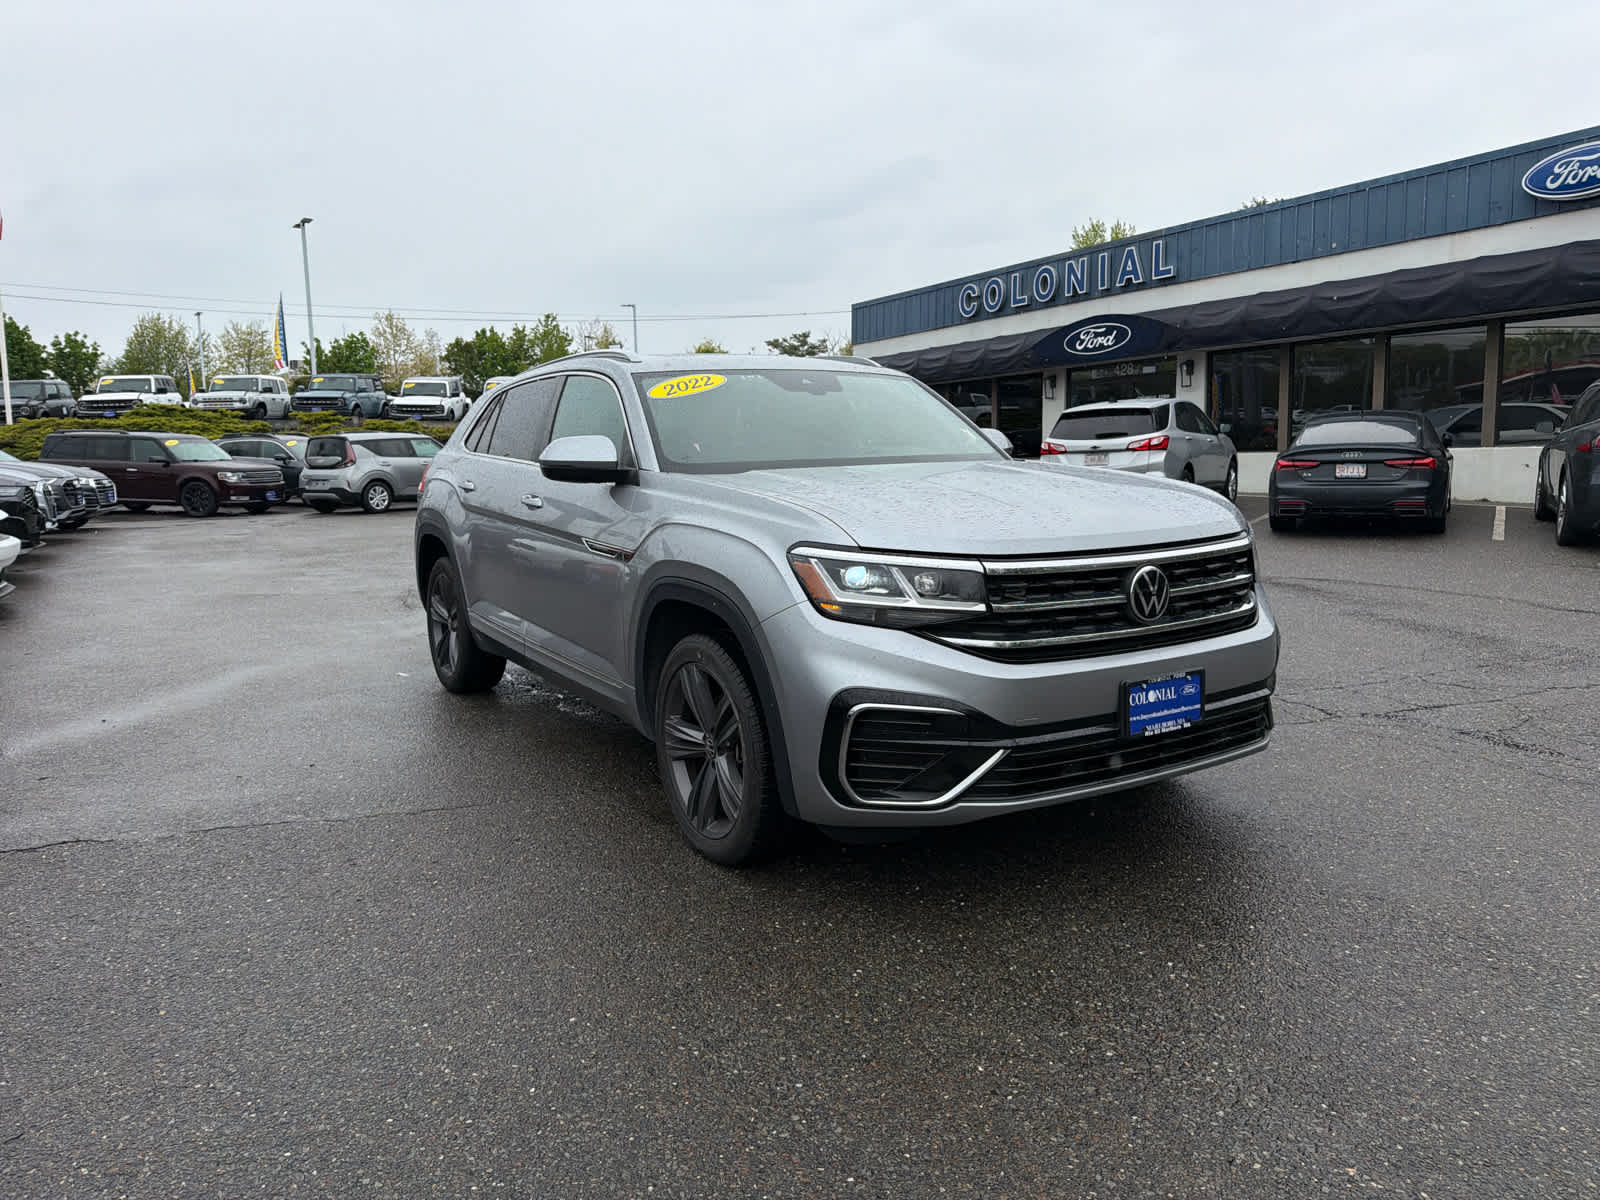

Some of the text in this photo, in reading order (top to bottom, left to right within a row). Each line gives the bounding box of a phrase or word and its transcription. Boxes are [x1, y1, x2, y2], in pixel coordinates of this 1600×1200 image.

[1546, 152, 1600, 190] For
[959, 240, 1174, 318] COLONIAL
[1076, 328, 1116, 351] Ford
[663, 375, 714, 396] 2022
[1129, 686, 1177, 706] COLONIAL
